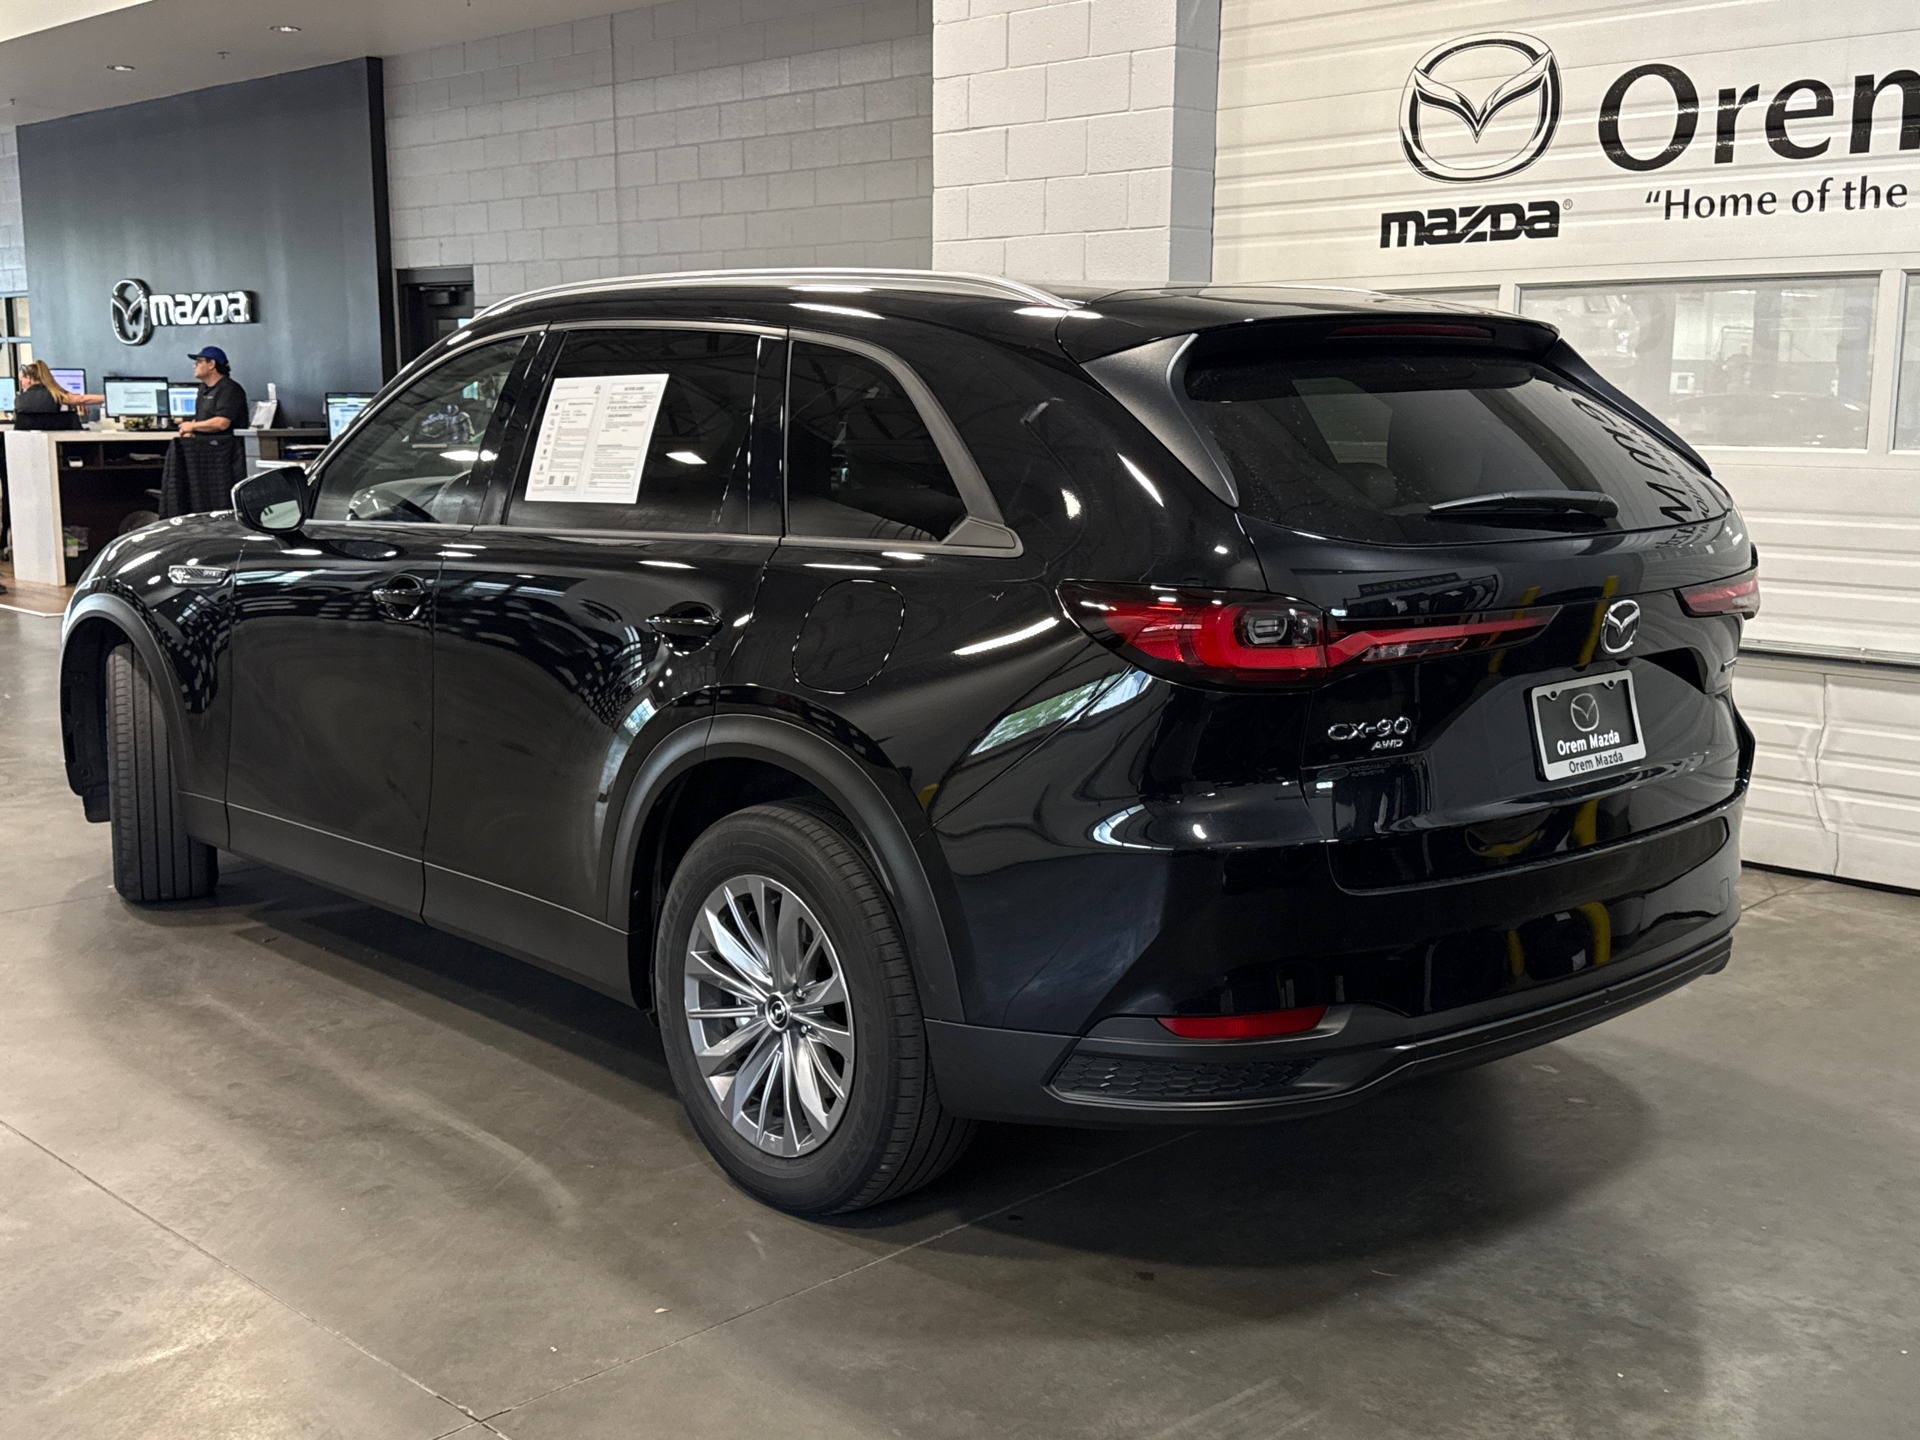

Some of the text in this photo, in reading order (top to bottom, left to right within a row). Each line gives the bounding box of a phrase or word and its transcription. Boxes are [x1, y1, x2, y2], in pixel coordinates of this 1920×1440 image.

[1791, 177, 1834, 214] of
[1842, 175, 1908, 211] the
[1328, 716, 1411, 741] CX-90
[1370, 739, 1404, 751] AWD
[1557, 729, 1621, 756] Orem Mazda
[1569, 750, 1624, 773] Orem Mazda
